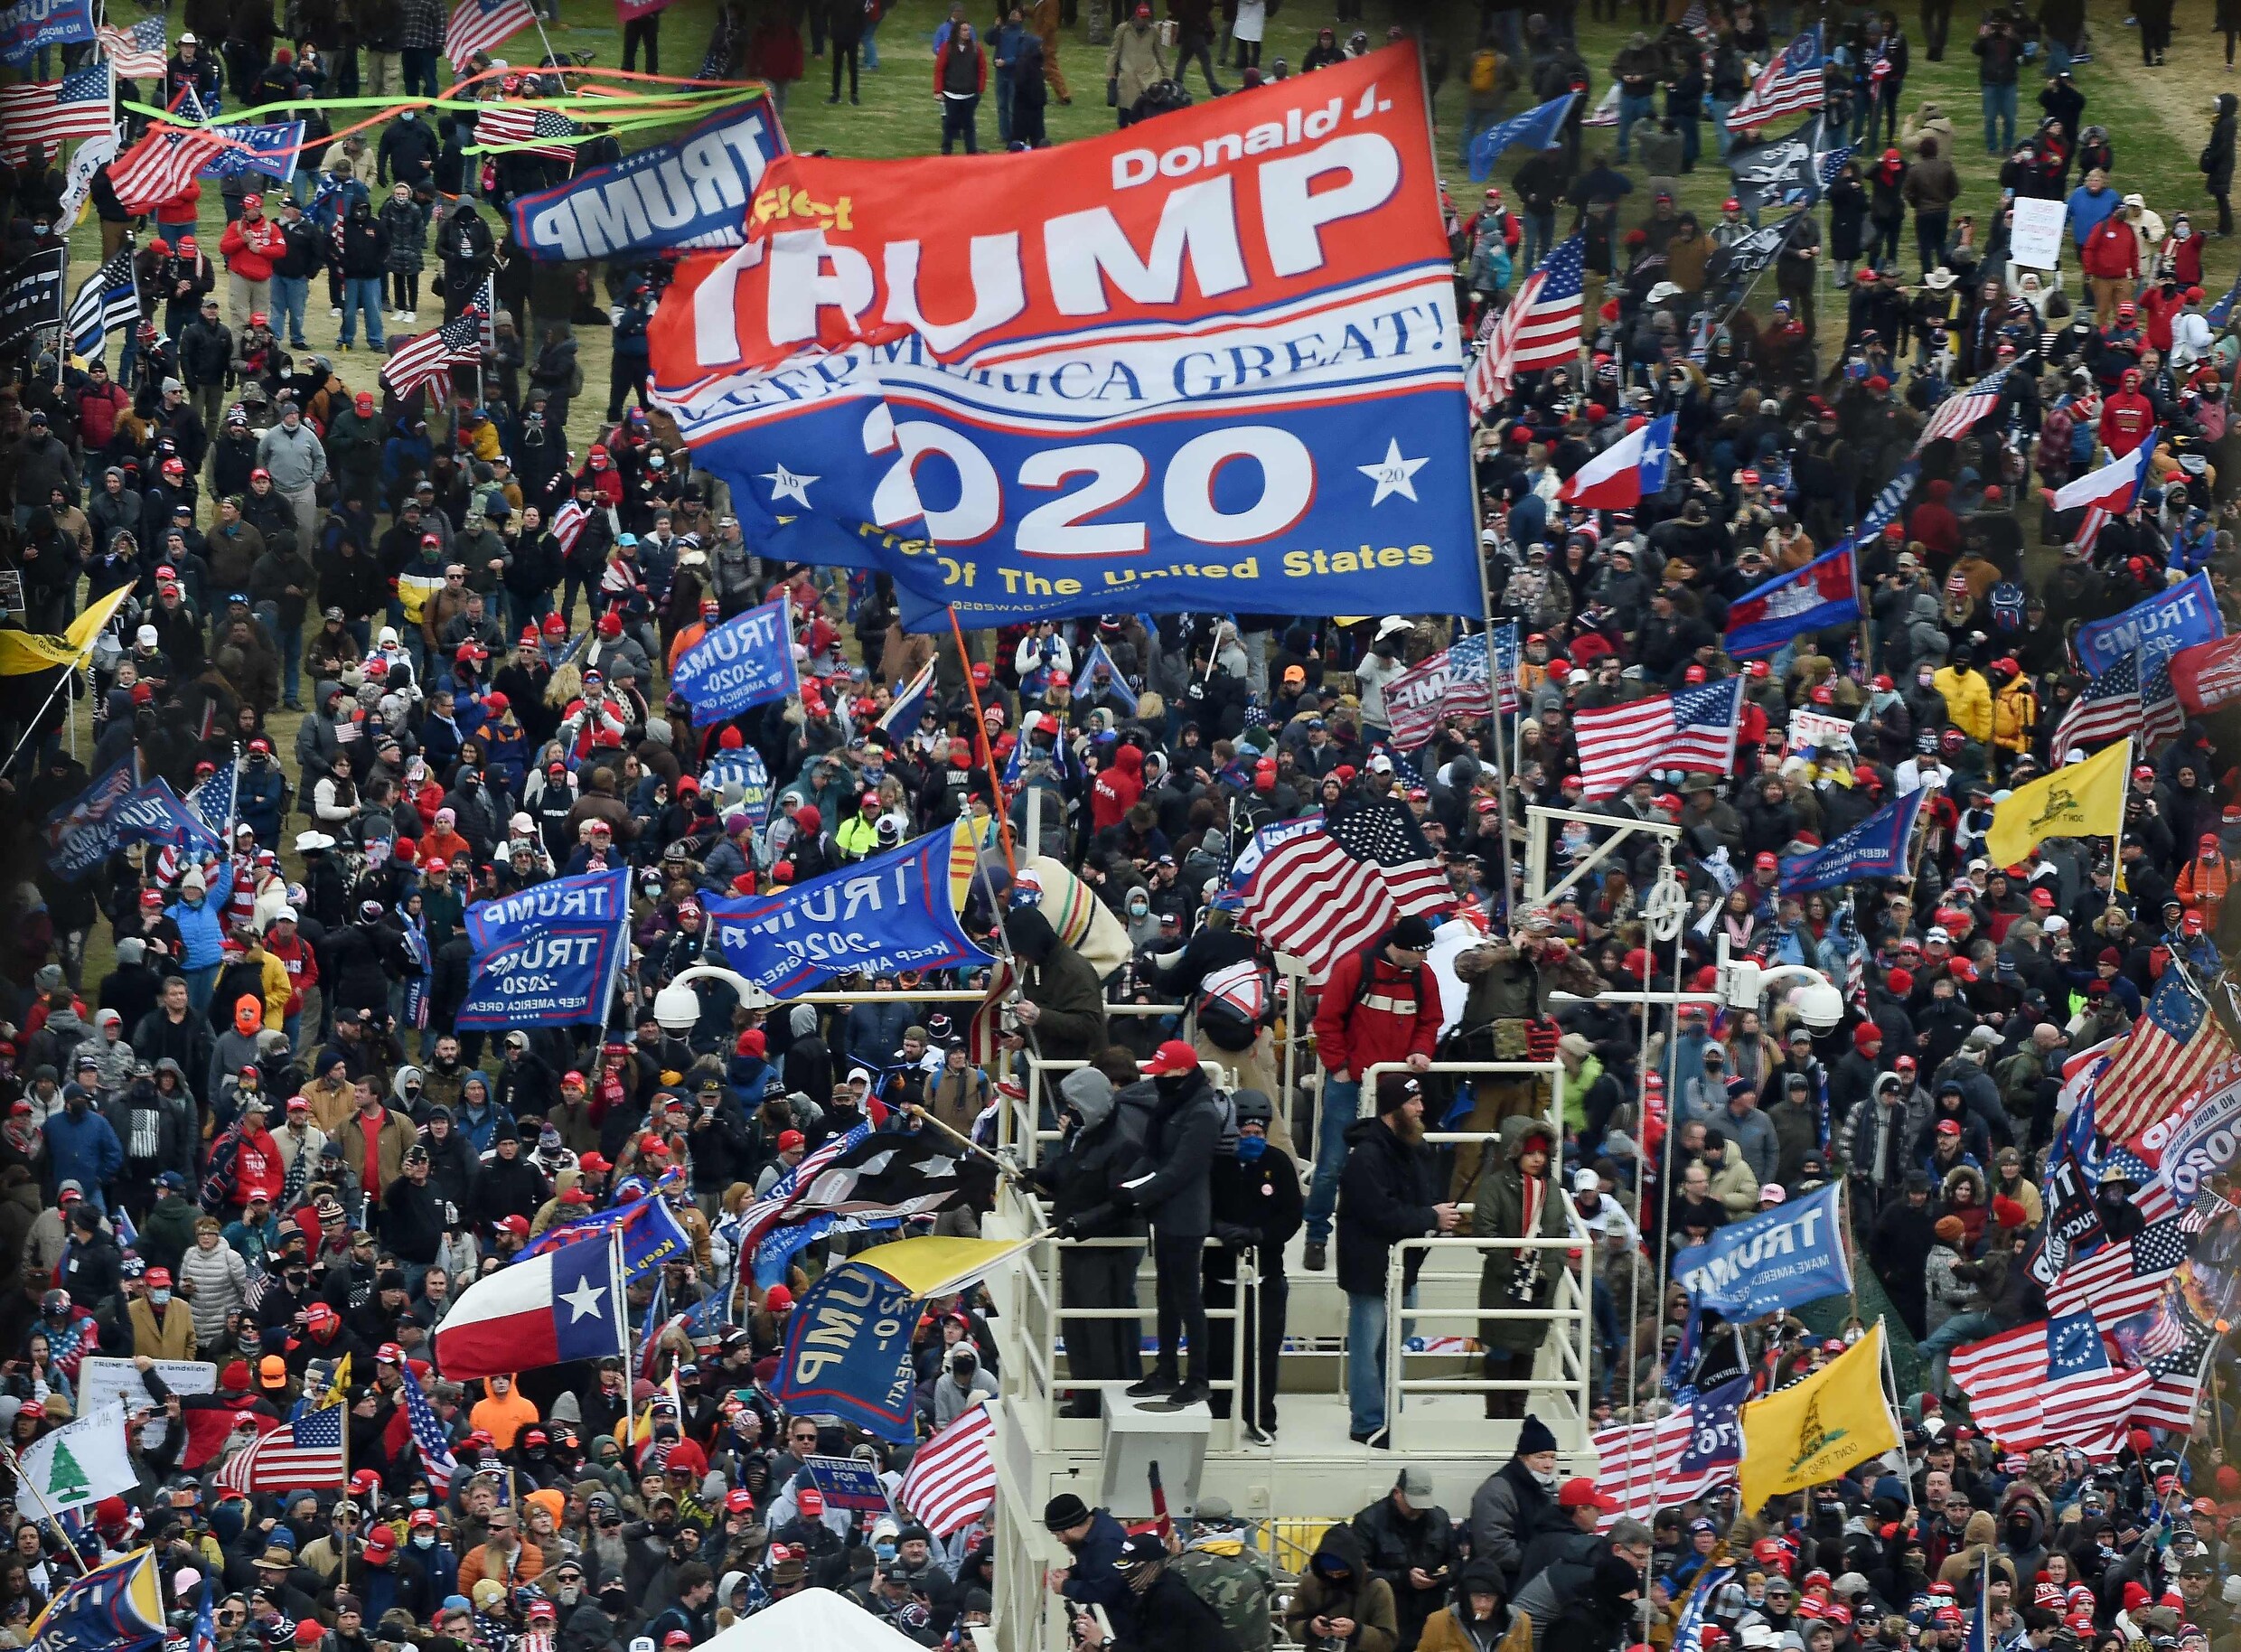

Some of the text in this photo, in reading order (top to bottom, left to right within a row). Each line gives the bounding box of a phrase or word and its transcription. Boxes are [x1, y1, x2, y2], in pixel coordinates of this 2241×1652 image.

[1111, 82, 1392, 190] Donald J.
[694, 133, 1400, 365] TRUMP
[1174, 302, 1444, 399] GREAT!
[862, 403, 1316, 556] 2020
[998, 567, 1083, 596] The
[1283, 542, 1434, 578] States
[1797, 715, 1851, 734] STOP
[409, 981, 420, 1020] TRUMP
[93, 1361, 123, 1370] TRUMP
[807, 1459, 871, 1472] VETERANS
[832, 1471, 858, 1483] FOR
[273, 1618, 295, 1638] TRU
